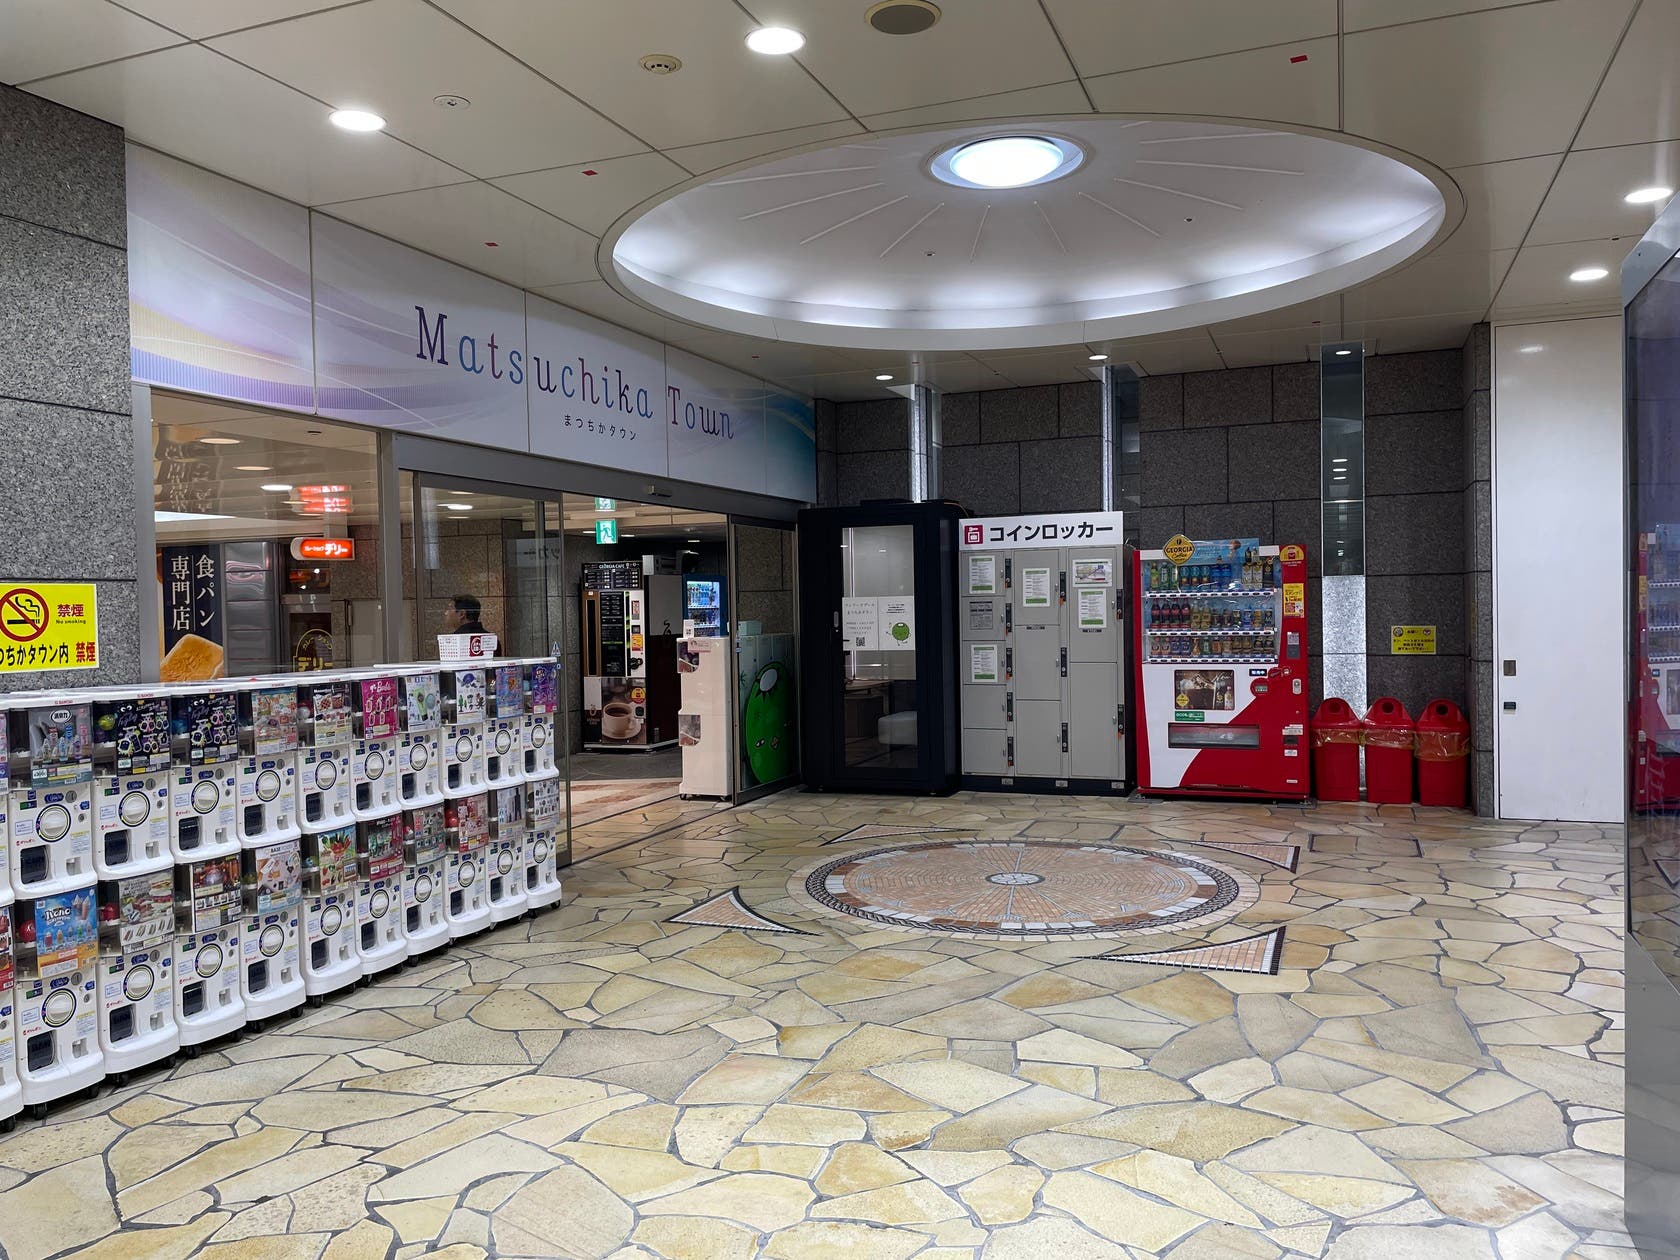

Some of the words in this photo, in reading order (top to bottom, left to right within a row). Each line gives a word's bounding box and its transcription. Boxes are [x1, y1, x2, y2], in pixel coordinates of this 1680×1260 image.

[414, 305, 653, 419] Matsuchika
[667, 385, 734, 439] Town
[563, 413, 638, 441] まつちかタウン
[990, 521, 1114, 542] コインロッカー
[324, 543, 349, 555] デリー
[1166, 546, 1193, 554] GEORGIA
[171, 556, 191, 631] 専門店
[196, 554, 215, 628] 食パン
[57, 604, 84, 617] 禁煙
[76, 641, 96, 663] 禁煙
[298, 657, 334, 671] デリー
